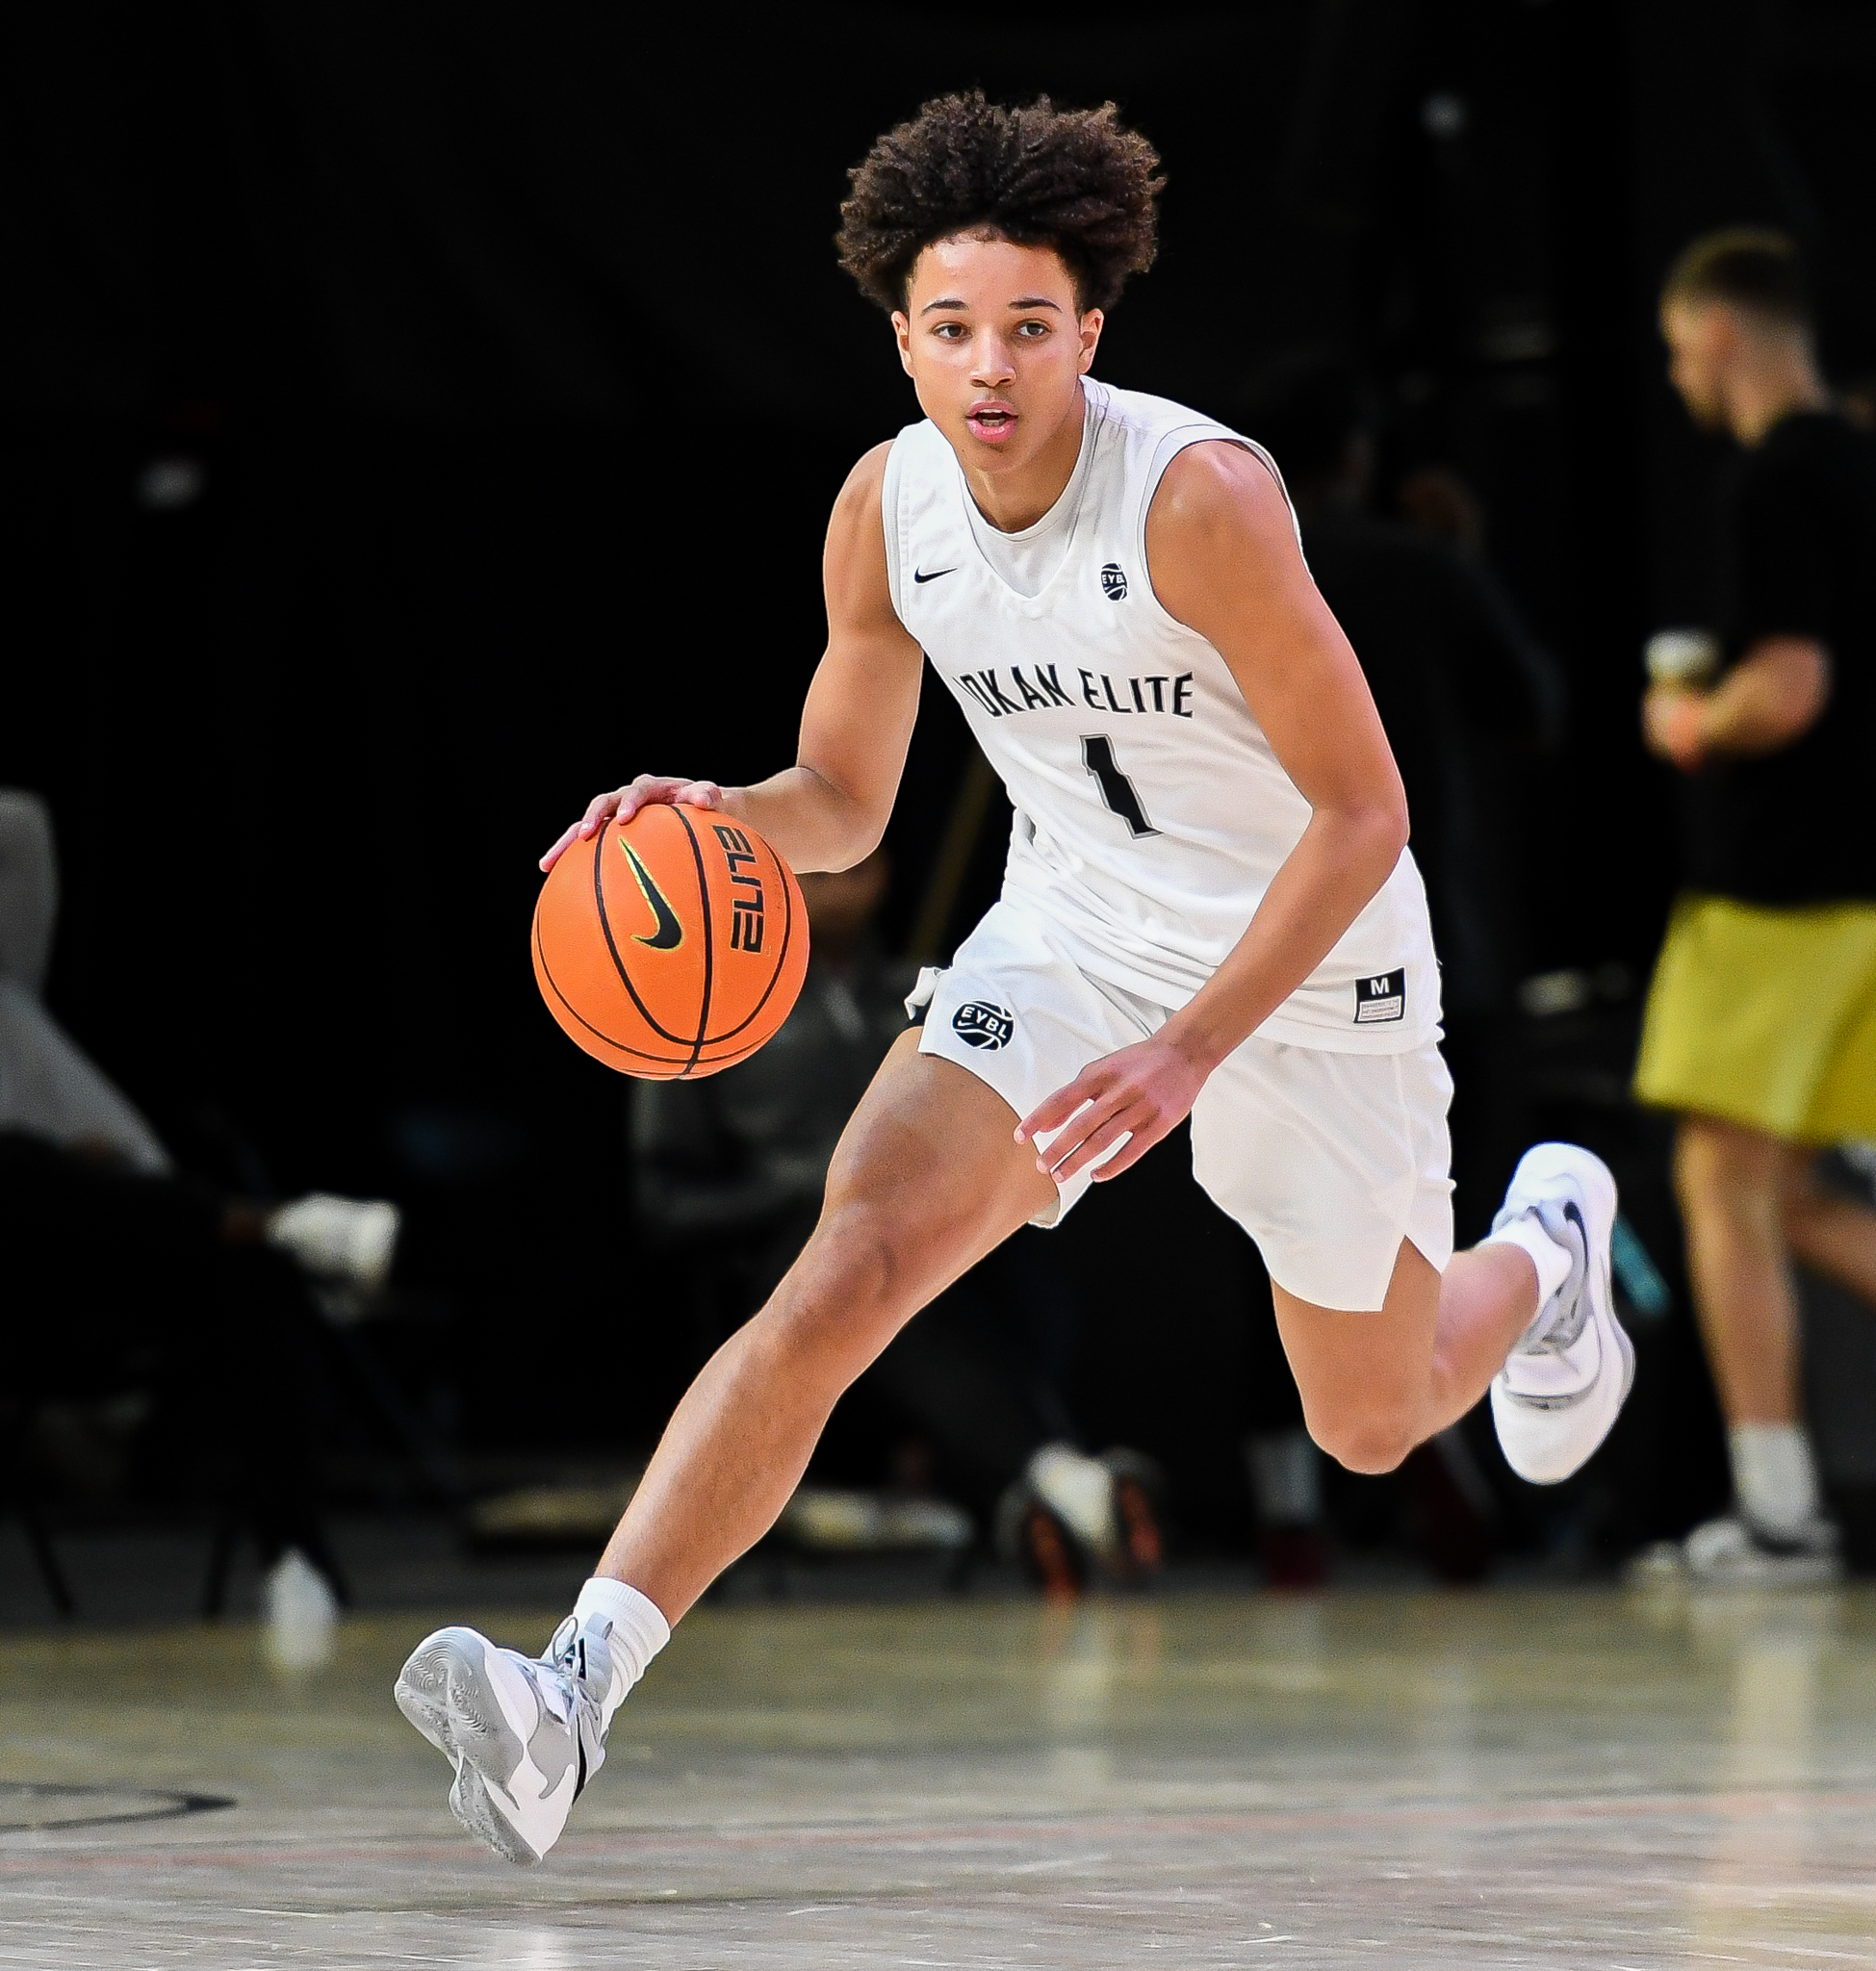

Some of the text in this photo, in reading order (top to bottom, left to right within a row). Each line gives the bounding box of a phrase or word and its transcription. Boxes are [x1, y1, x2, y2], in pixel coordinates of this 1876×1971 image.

[953, 663, 1194, 719] OKAN ELITE
[1079, 733, 1164, 839] 1
[711, 824, 764, 954] ELITE
[1371, 977, 1390, 996] M
[961, 1006, 1007, 1039] EYBL
